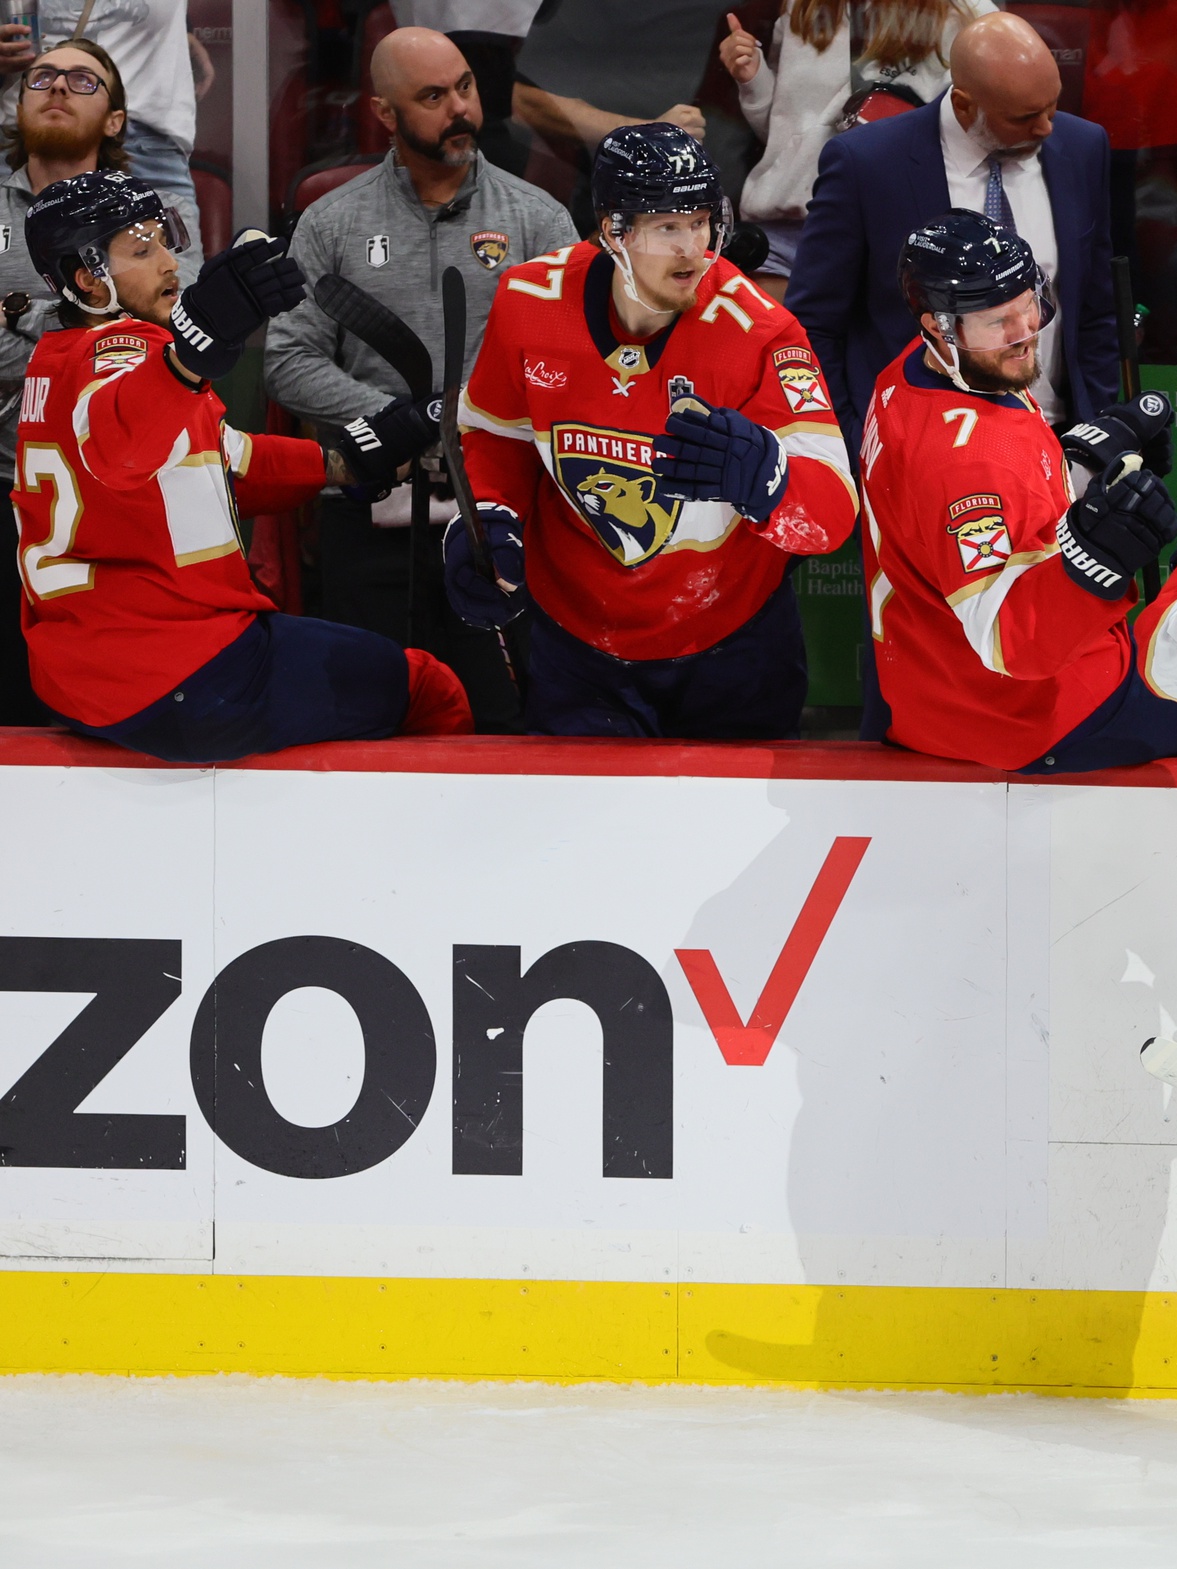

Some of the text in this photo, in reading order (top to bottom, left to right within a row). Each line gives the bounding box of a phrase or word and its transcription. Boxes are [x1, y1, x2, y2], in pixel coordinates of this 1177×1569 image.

[668, 153, 697, 174] 77
[672, 182, 708, 194] BAUER
[913, 240, 946, 255] LAUDERDALE
[994, 259, 1025, 282] WARRIOR
[699, 274, 776, 333] 77
[100, 336, 142, 348] FLORIDA
[777, 348, 809, 362] FLORIDA
[18, 377, 50, 425] OUR
[941, 407, 979, 448] 7
[954, 497, 995, 513] FLORIDA
[12, 440, 97, 606] 2
[808, 558, 862, 580] Baptis
[808, 579, 865, 595] Health
